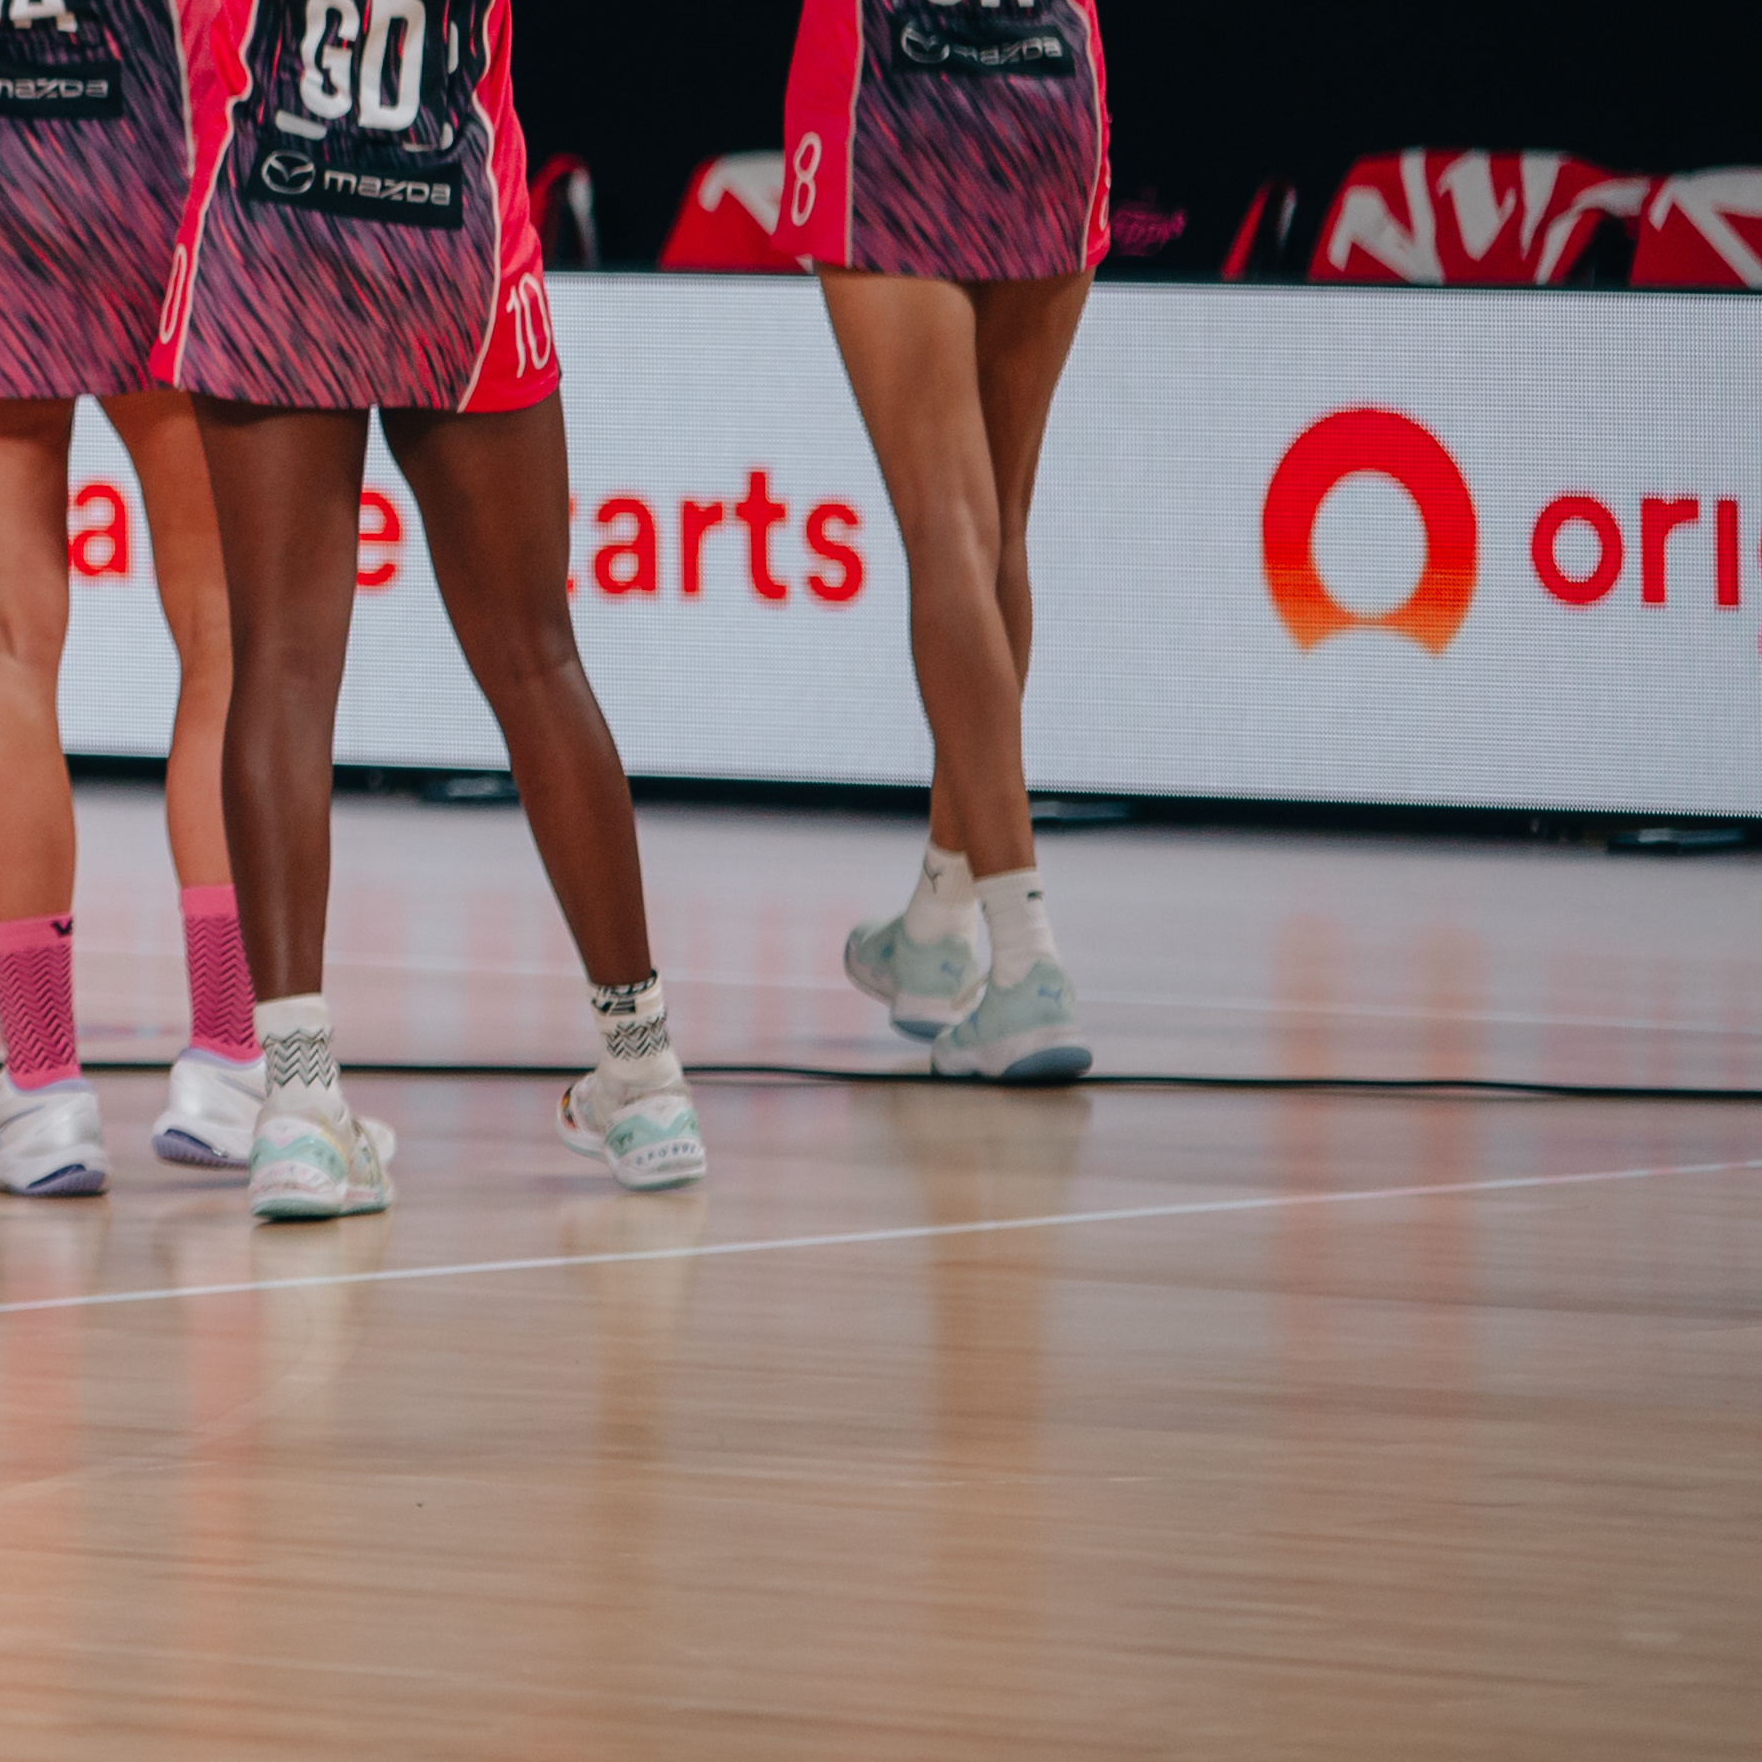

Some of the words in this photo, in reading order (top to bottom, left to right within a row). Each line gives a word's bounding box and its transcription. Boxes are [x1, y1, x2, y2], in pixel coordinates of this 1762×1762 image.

[324, 169, 452, 207] mazda
[791, 132, 822, 228] 8
[506, 271, 553, 379] 10
[567, 470, 867, 604] arts
[1530, 492, 1762, 612] ori
